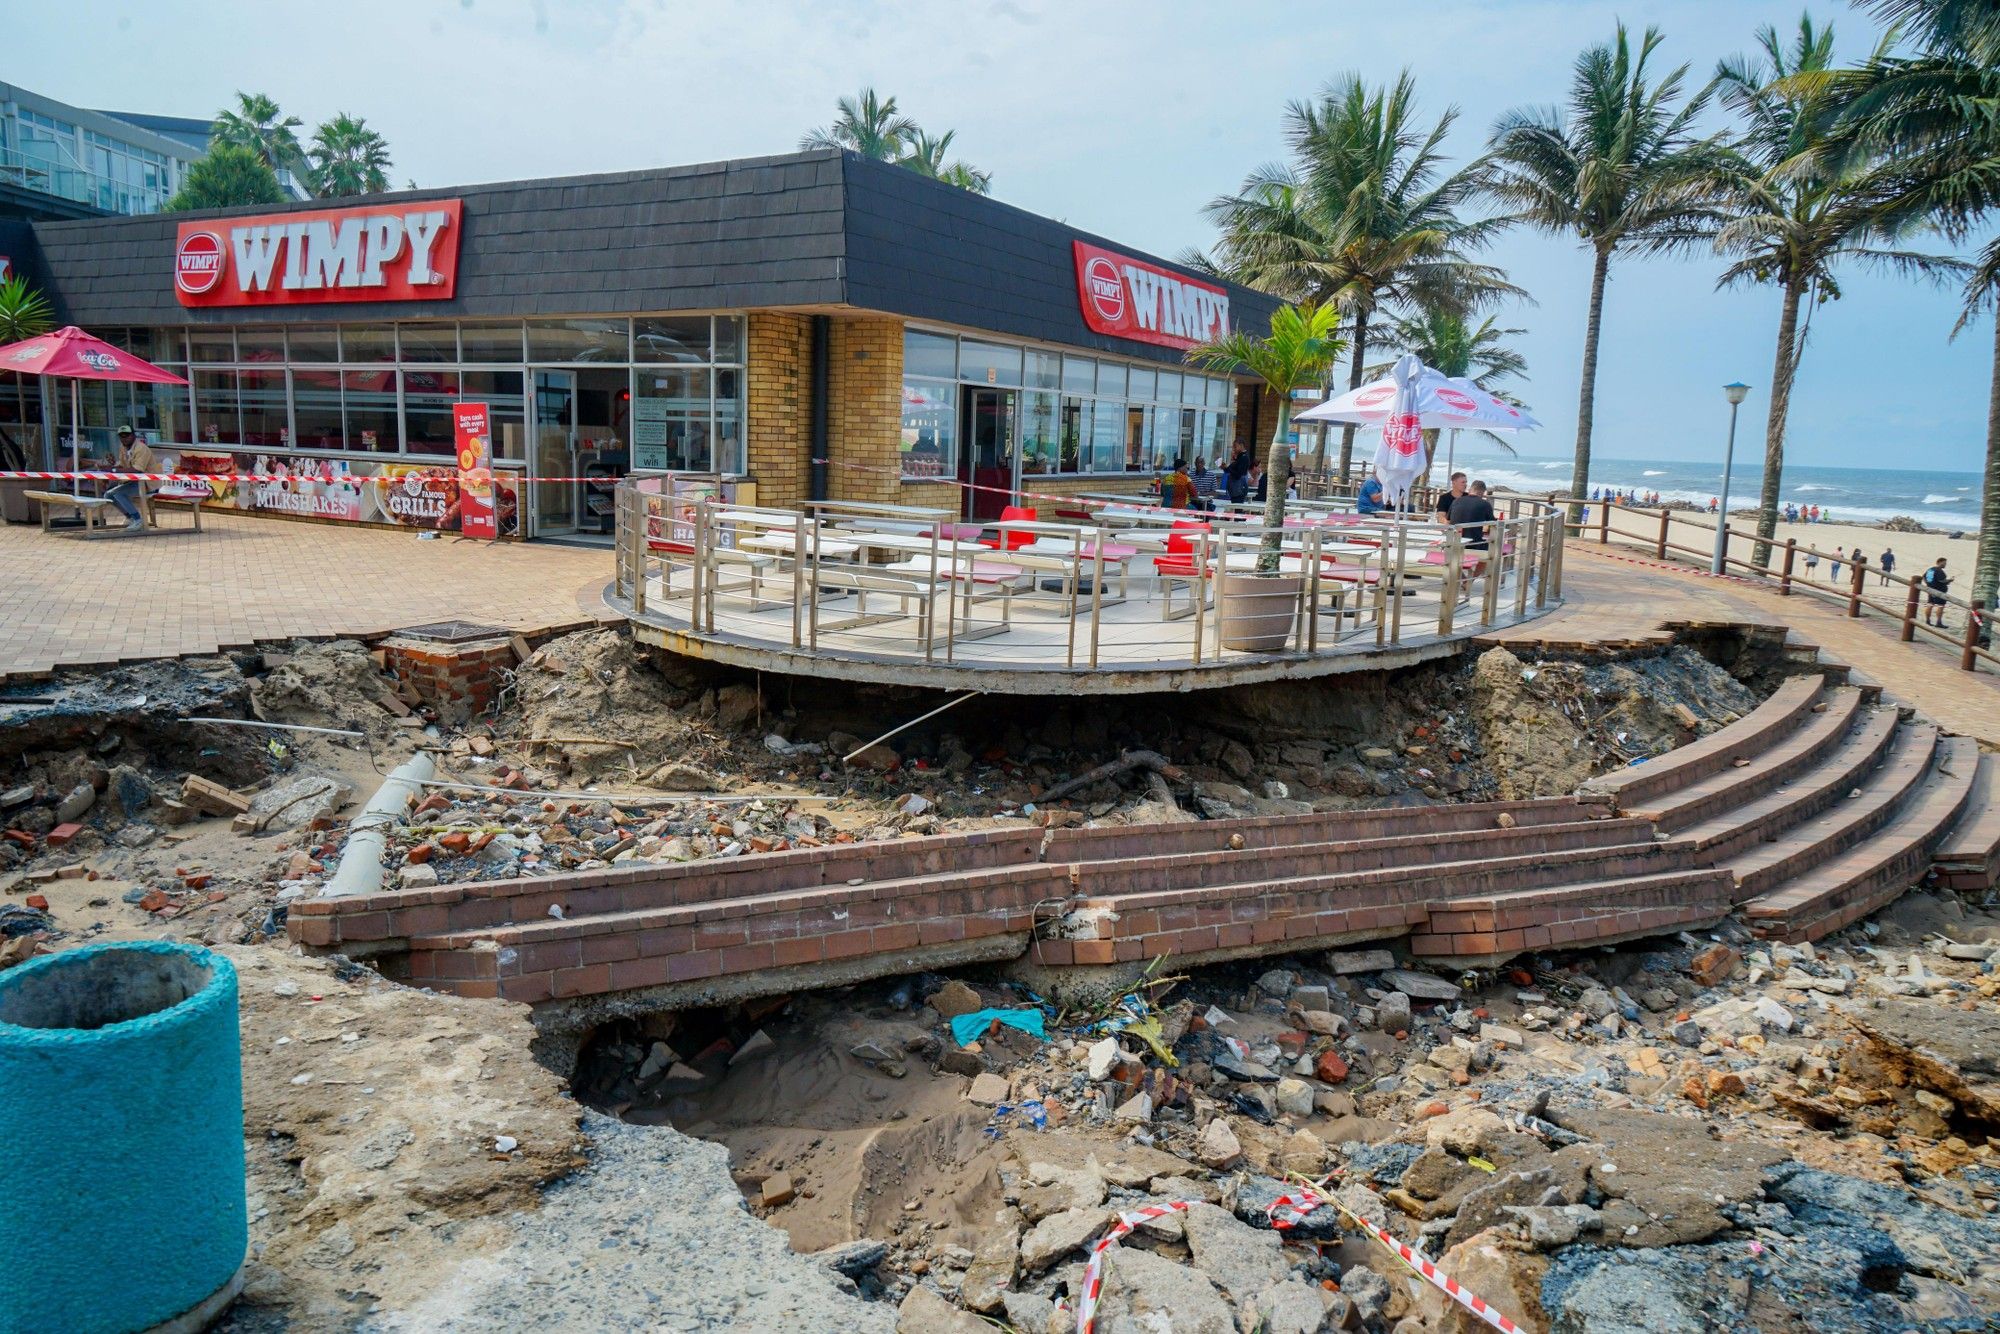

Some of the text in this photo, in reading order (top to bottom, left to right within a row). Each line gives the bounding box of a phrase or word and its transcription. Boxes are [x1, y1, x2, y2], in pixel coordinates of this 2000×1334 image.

[231, 211, 449, 291] WIMPY
[180, 253, 219, 271] WIMPY
[1092, 279, 1120, 299] WIMPY
[1122, 264, 1230, 343] WIMPY
[472, 413, 484, 421] cash
[256, 490, 349, 515] MILKSHAKES
[421, 490, 446, 499] FAMOUS
[390, 495, 446, 517] GRILLS
